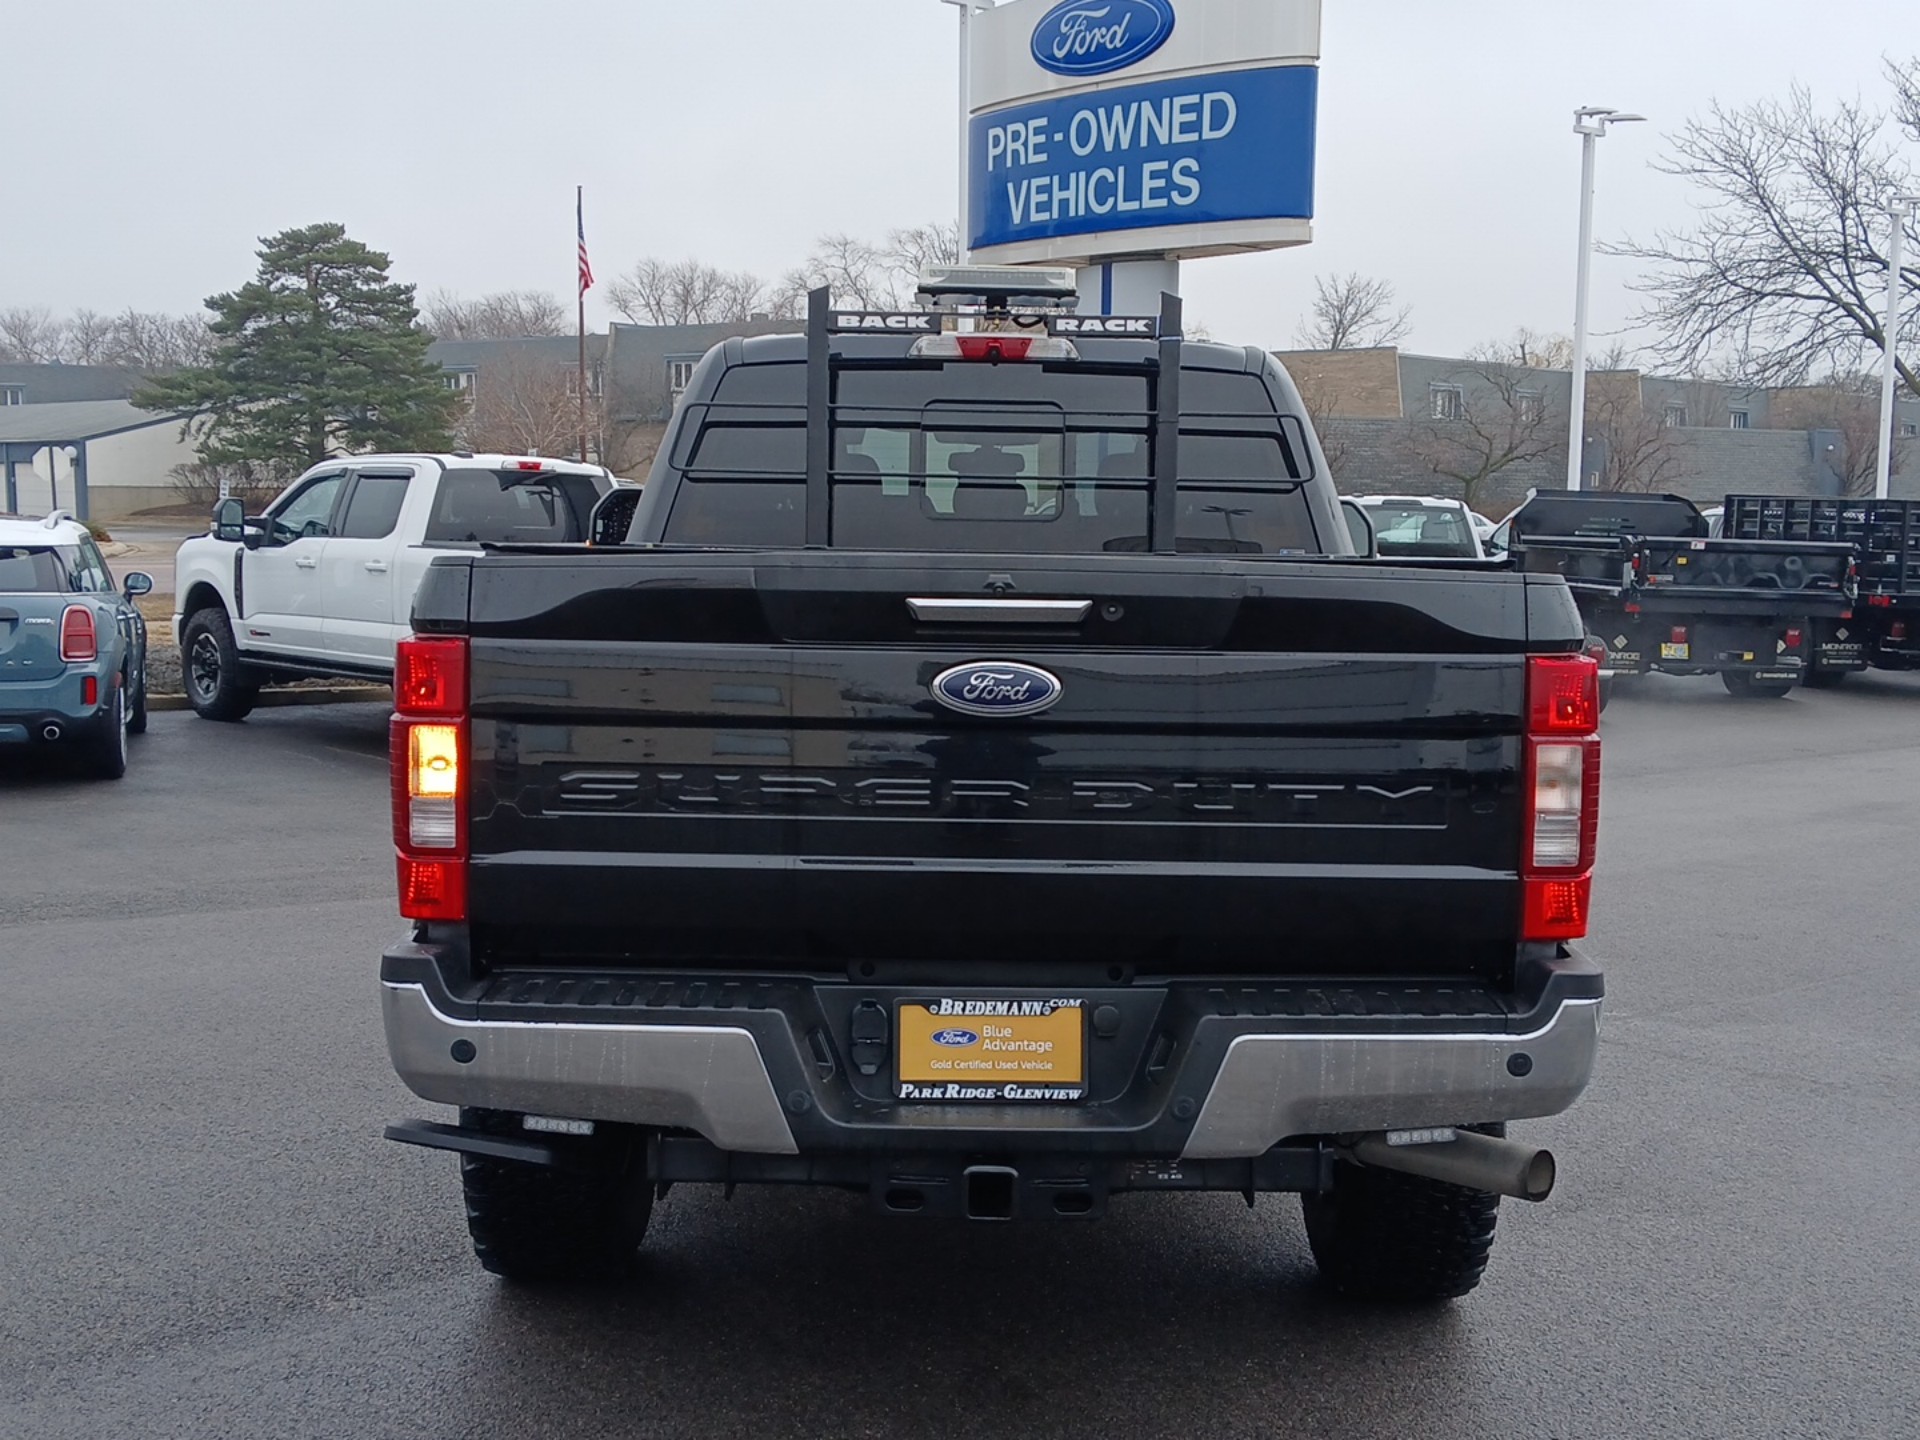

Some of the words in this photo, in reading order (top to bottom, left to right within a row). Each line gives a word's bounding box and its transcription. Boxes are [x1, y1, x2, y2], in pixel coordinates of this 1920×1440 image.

[1052, 6, 1132, 59] Ford
[987, 91, 1237, 172] PRE-OWNED
[1007, 157, 1201, 225] VEHICLES
[836, 315, 931, 329] BACK
[1055, 319, 1149, 332] RACK
[963, 671, 1032, 700] Ford
[983, 1025, 1012, 1037] Blue
[982, 1039, 1053, 1053] Advantage
[930, 1059, 952, 1070] Gold
[954, 1059, 993, 1070] Certified
[995, 1060, 1018, 1070] Used
[1020, 1060, 1053, 1071] Vehicle
[899, 1083, 945, 1099] PARK
